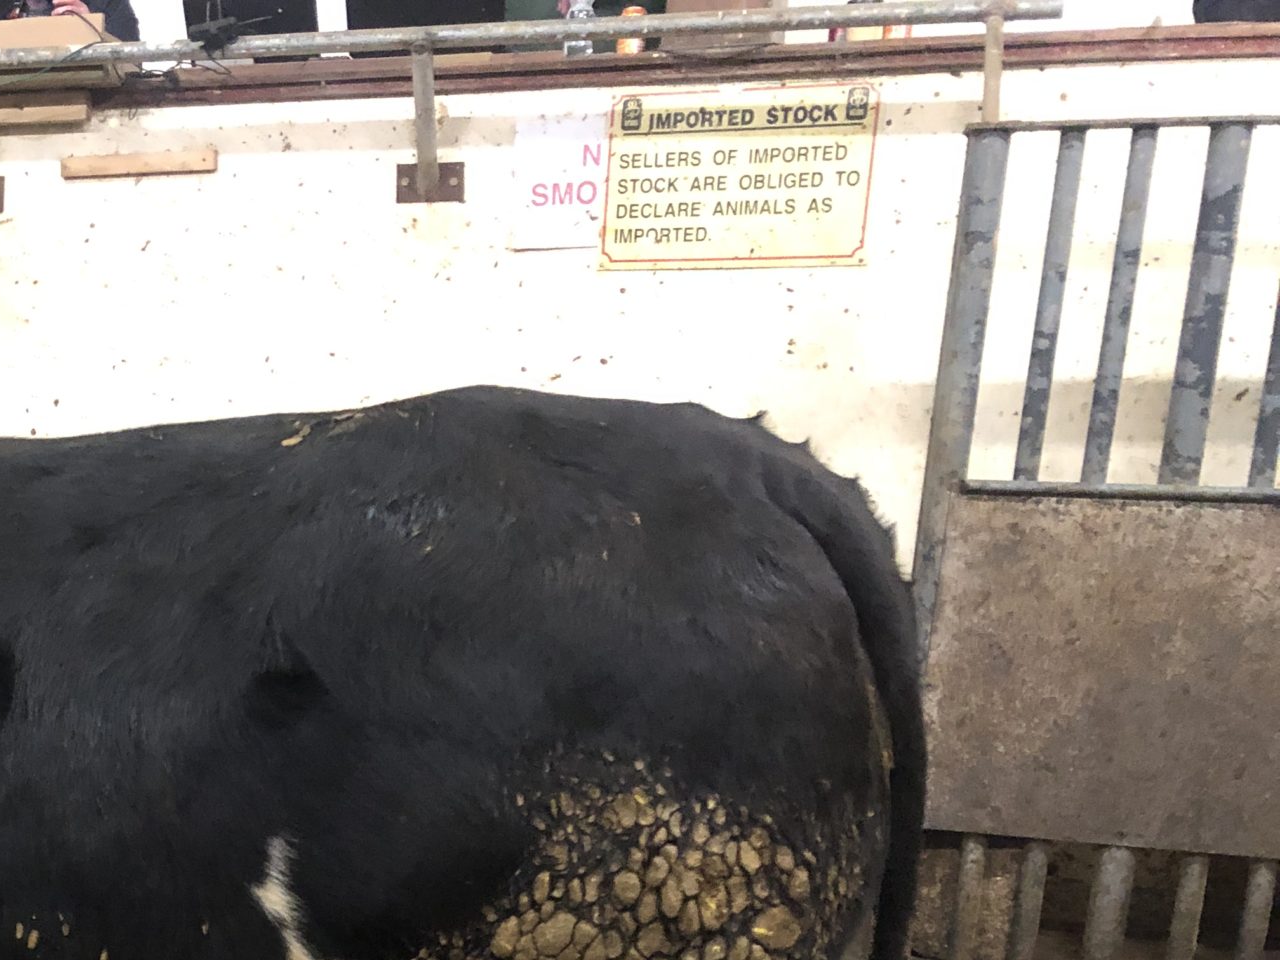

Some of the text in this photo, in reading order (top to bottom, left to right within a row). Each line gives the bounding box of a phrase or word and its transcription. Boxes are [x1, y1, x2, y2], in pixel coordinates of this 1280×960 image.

[648, 105, 838, 131] IMPORTED STOCK
[619, 144, 848, 169] SELLERS OF IMPORTED
[617, 170, 860, 194] STOCK ARE OBLIGED TO
[616, 198, 833, 219] DECLARE ANIMALS AS
